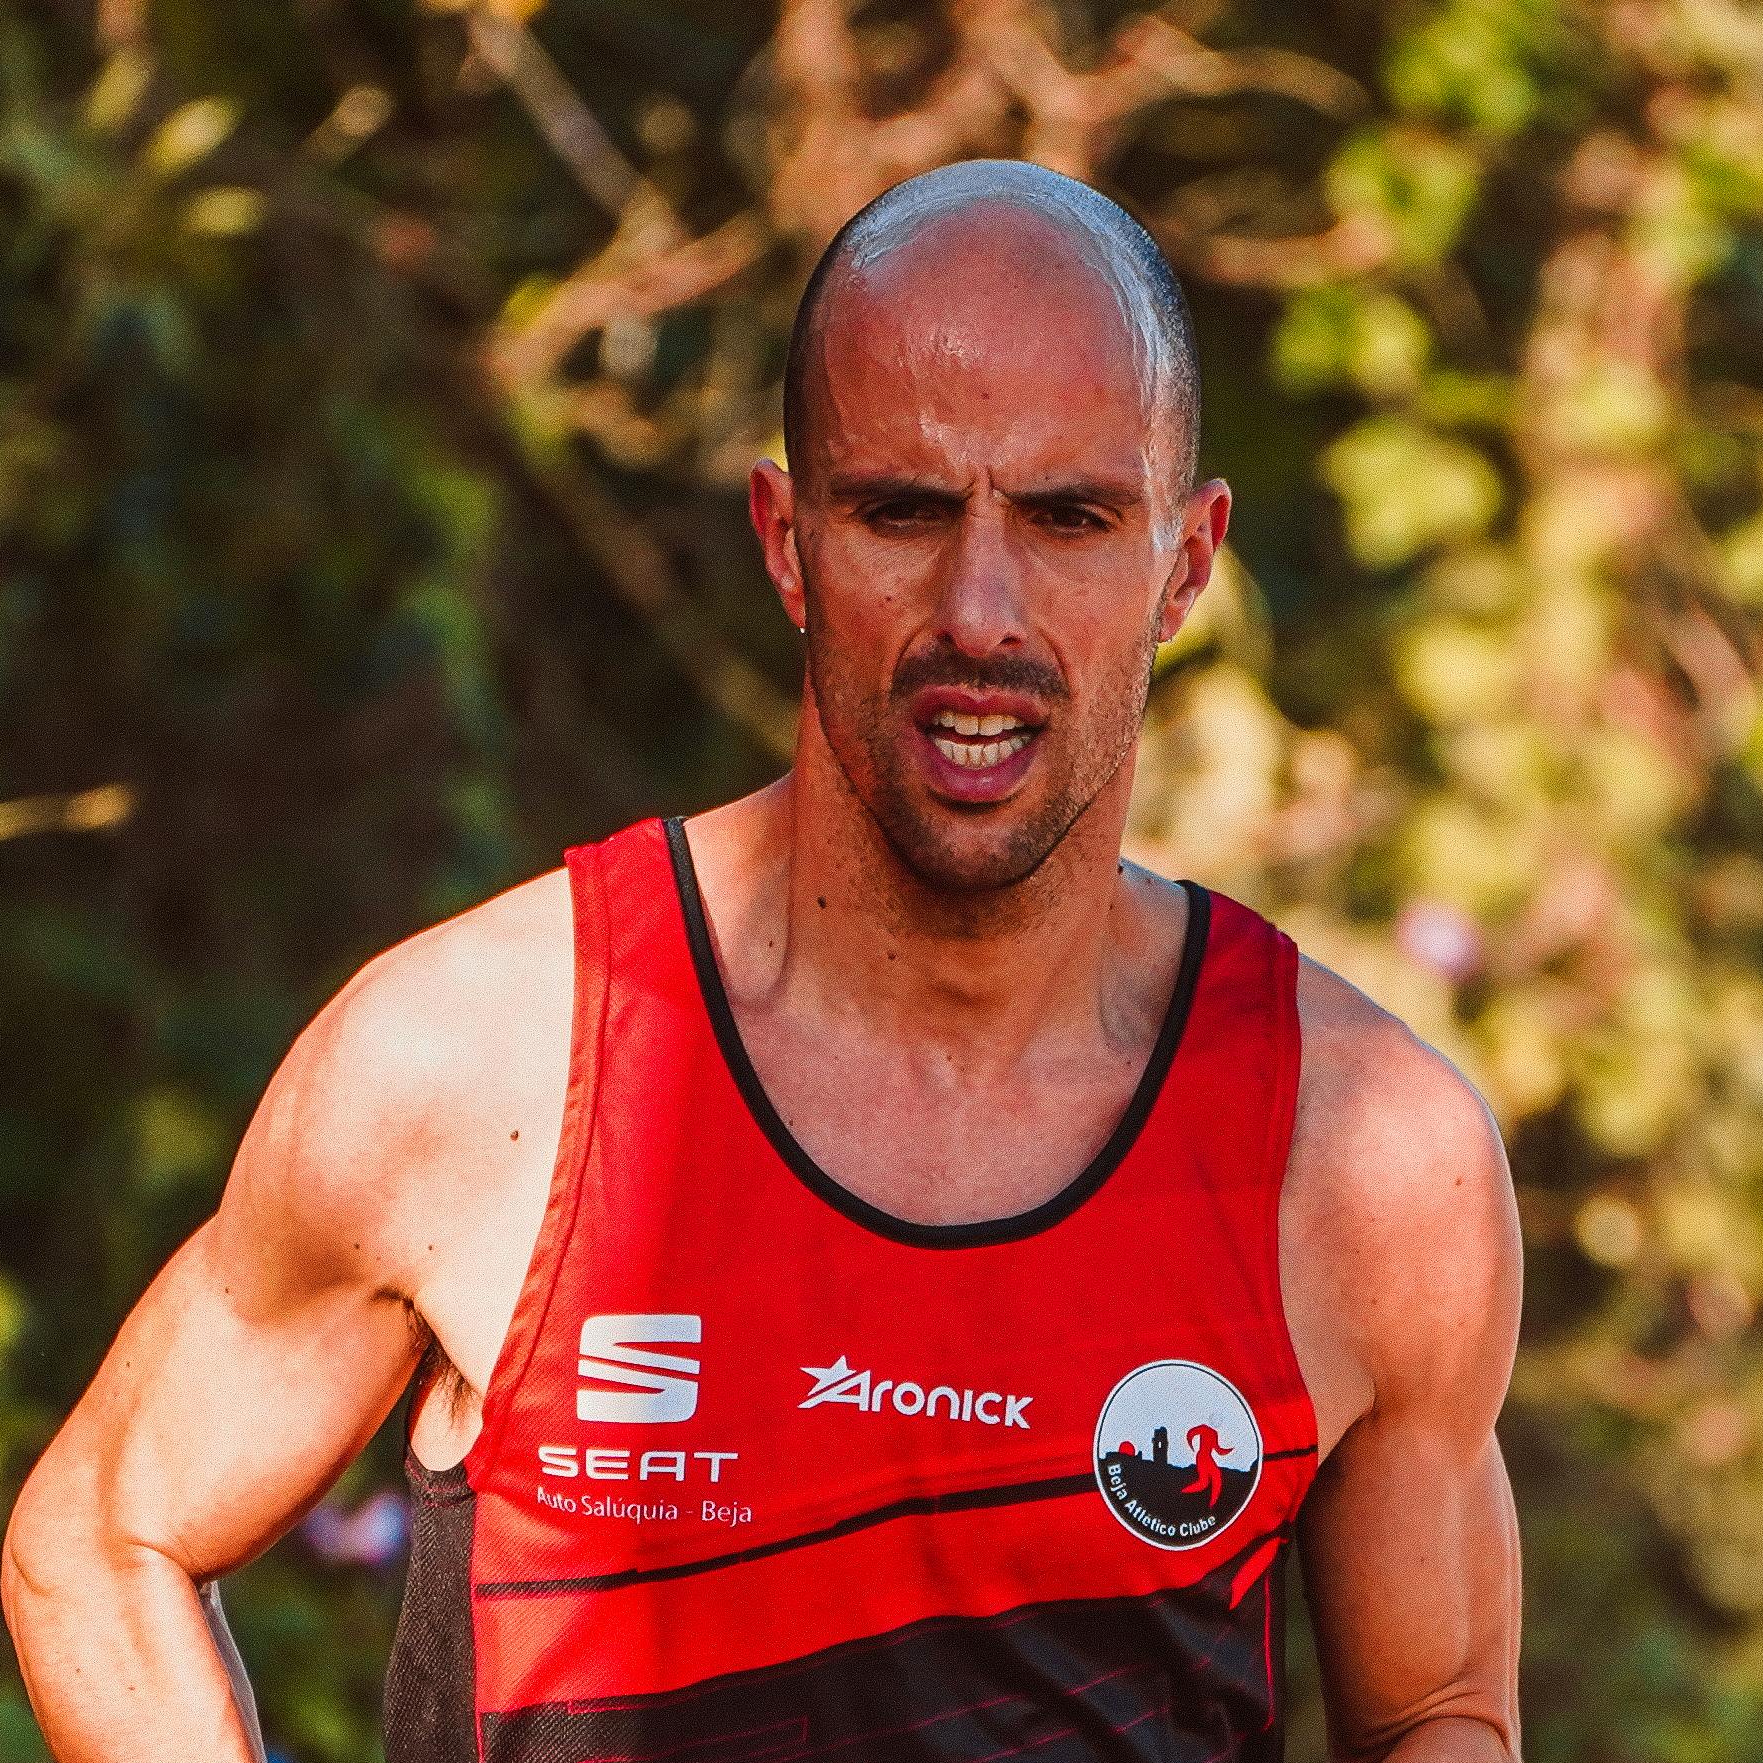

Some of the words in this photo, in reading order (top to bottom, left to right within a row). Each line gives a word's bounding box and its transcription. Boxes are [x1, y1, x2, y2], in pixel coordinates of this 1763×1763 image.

[538, 1445, 739, 1483] SEAT
[537, 1486, 578, 1513] Auto
[581, 1495, 679, 1525] Salúquia
[701, 1500, 752, 1527] Beja
[1107, 1463, 1128, 1500] Beja
[1179, 1515, 1216, 1537] Clube
